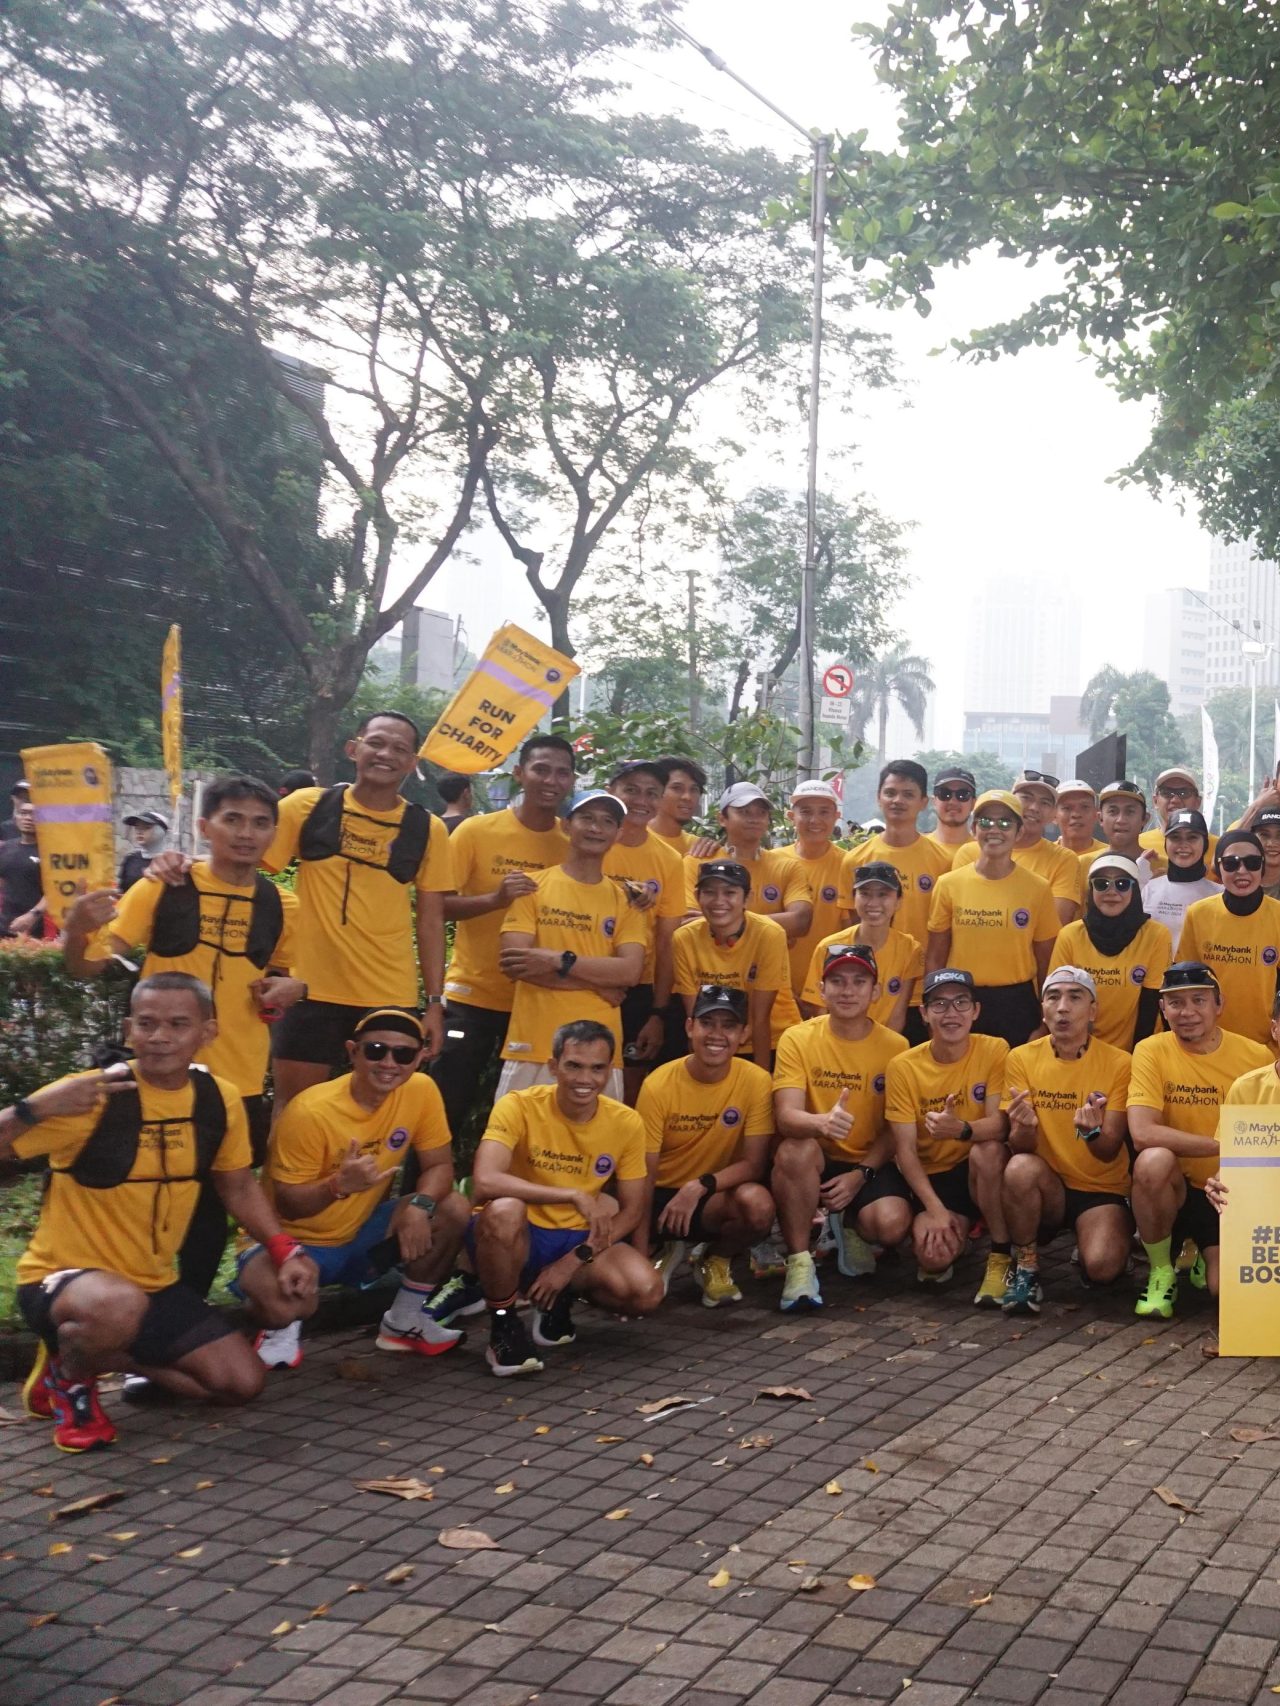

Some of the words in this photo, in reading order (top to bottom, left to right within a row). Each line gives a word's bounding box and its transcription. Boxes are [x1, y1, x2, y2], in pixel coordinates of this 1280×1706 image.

[478, 698, 517, 725] RUN
[468, 715, 504, 741] FOR
[437, 722, 503, 764] CHARITY
[50, 853, 90, 871] RUN
[551, 907, 592, 921] Maybank
[963, 908, 1003, 919] Maybank
[1213, 944, 1252, 956] Maybank
[1203, 953, 1252, 965] MARATHON
[702, 971, 740, 981] Maybank
[934, 971, 966, 984] HOKA
[1084, 967, 1121, 978] Maybank
[823, 1071, 862, 1083] Maybank
[1038, 1089, 1077, 1101] Maybank
[1176, 1084, 1218, 1095] Maybank
[1033, 1099, 1078, 1111] ARATHON
[1164, 1094, 1219, 1106] MARATHON
[541, 1148, 584, 1163] Maybank
[527, 1159, 583, 1177] MARATHON
